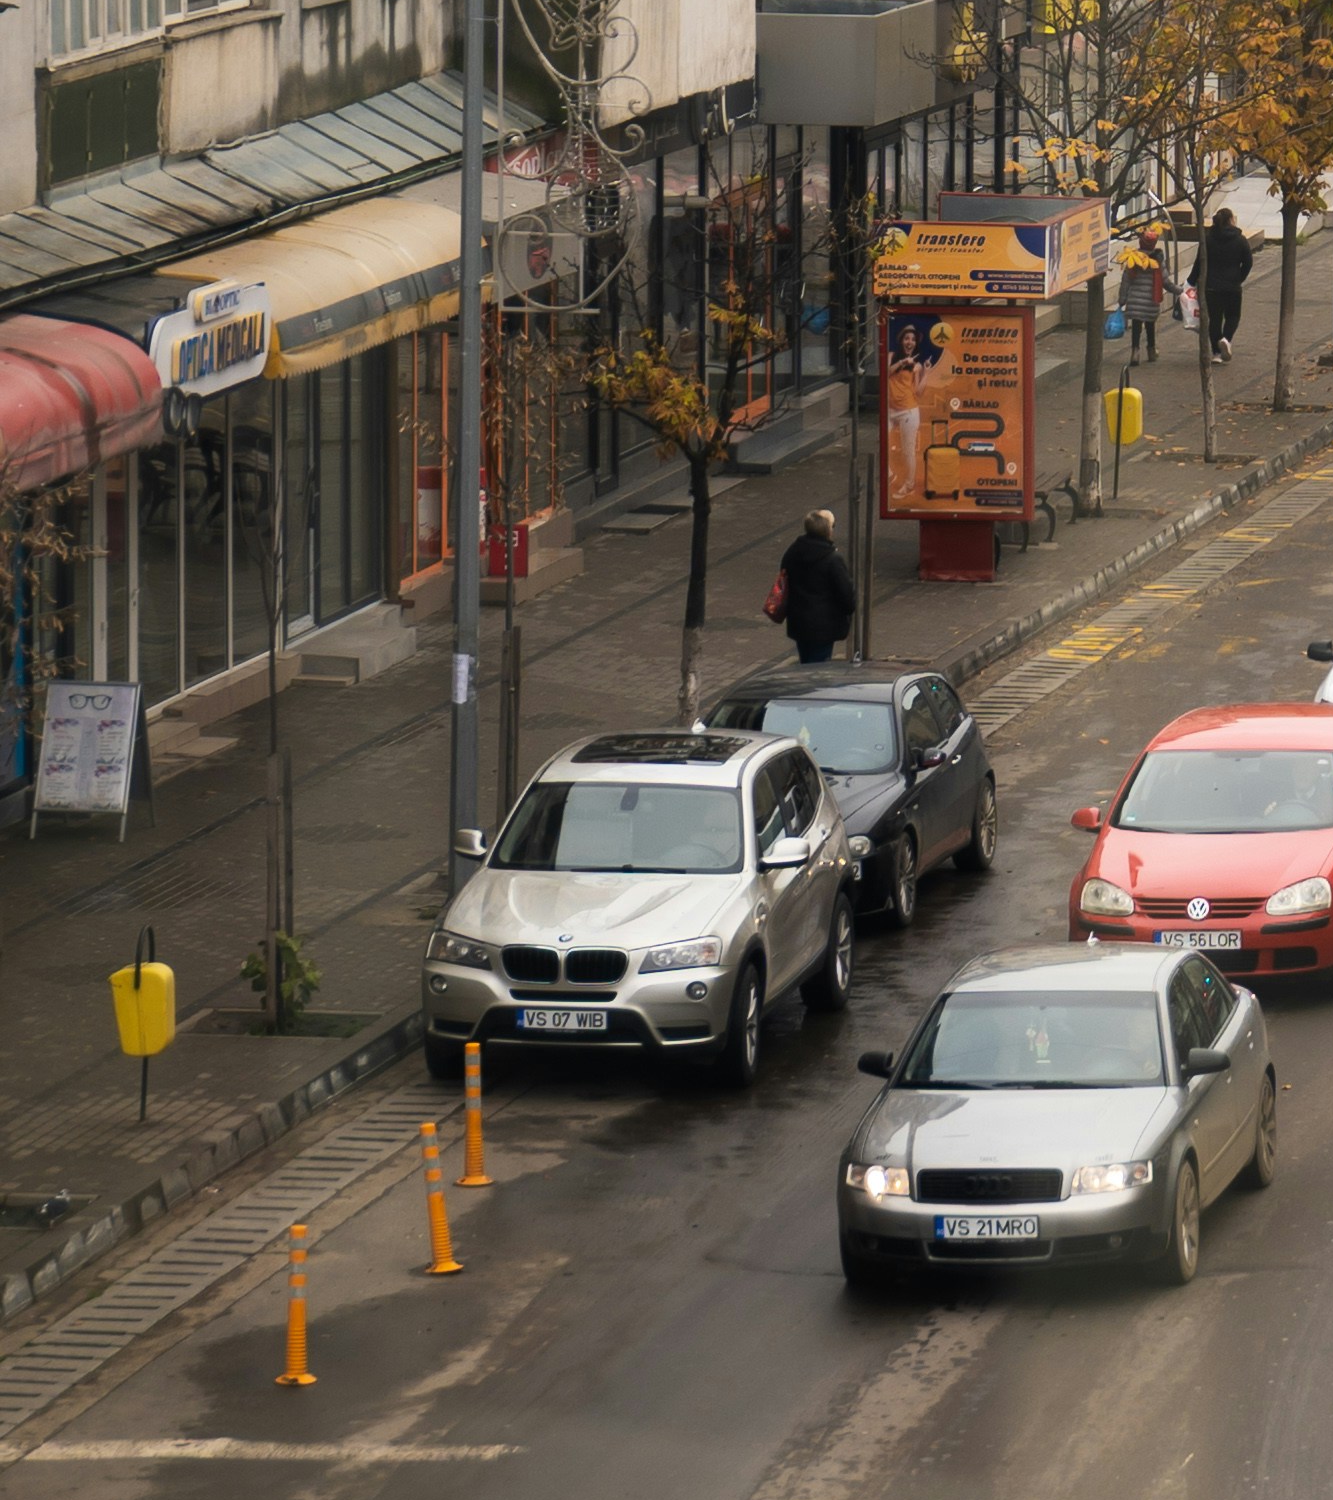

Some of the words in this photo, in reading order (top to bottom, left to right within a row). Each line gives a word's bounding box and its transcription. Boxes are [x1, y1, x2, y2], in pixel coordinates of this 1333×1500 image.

[916, 233, 986, 246] transfero
[961, 327, 1018, 338] transfero
[963, 353, 978, 363] De
[981, 353, 1018, 363] acasă
[952, 365, 963, 374] la
[966, 366, 1018, 377] aeroport
[989, 379, 1018, 388] retur
[962, 398, 999, 409] BÂRLAD
[1164, 933, 1184, 948] VS
[526, 1011, 547, 1027] VS
[552, 1012, 571, 1028] 07
[576, 1012, 604, 1028] WIB
[946, 1219, 970, 1236] VS
